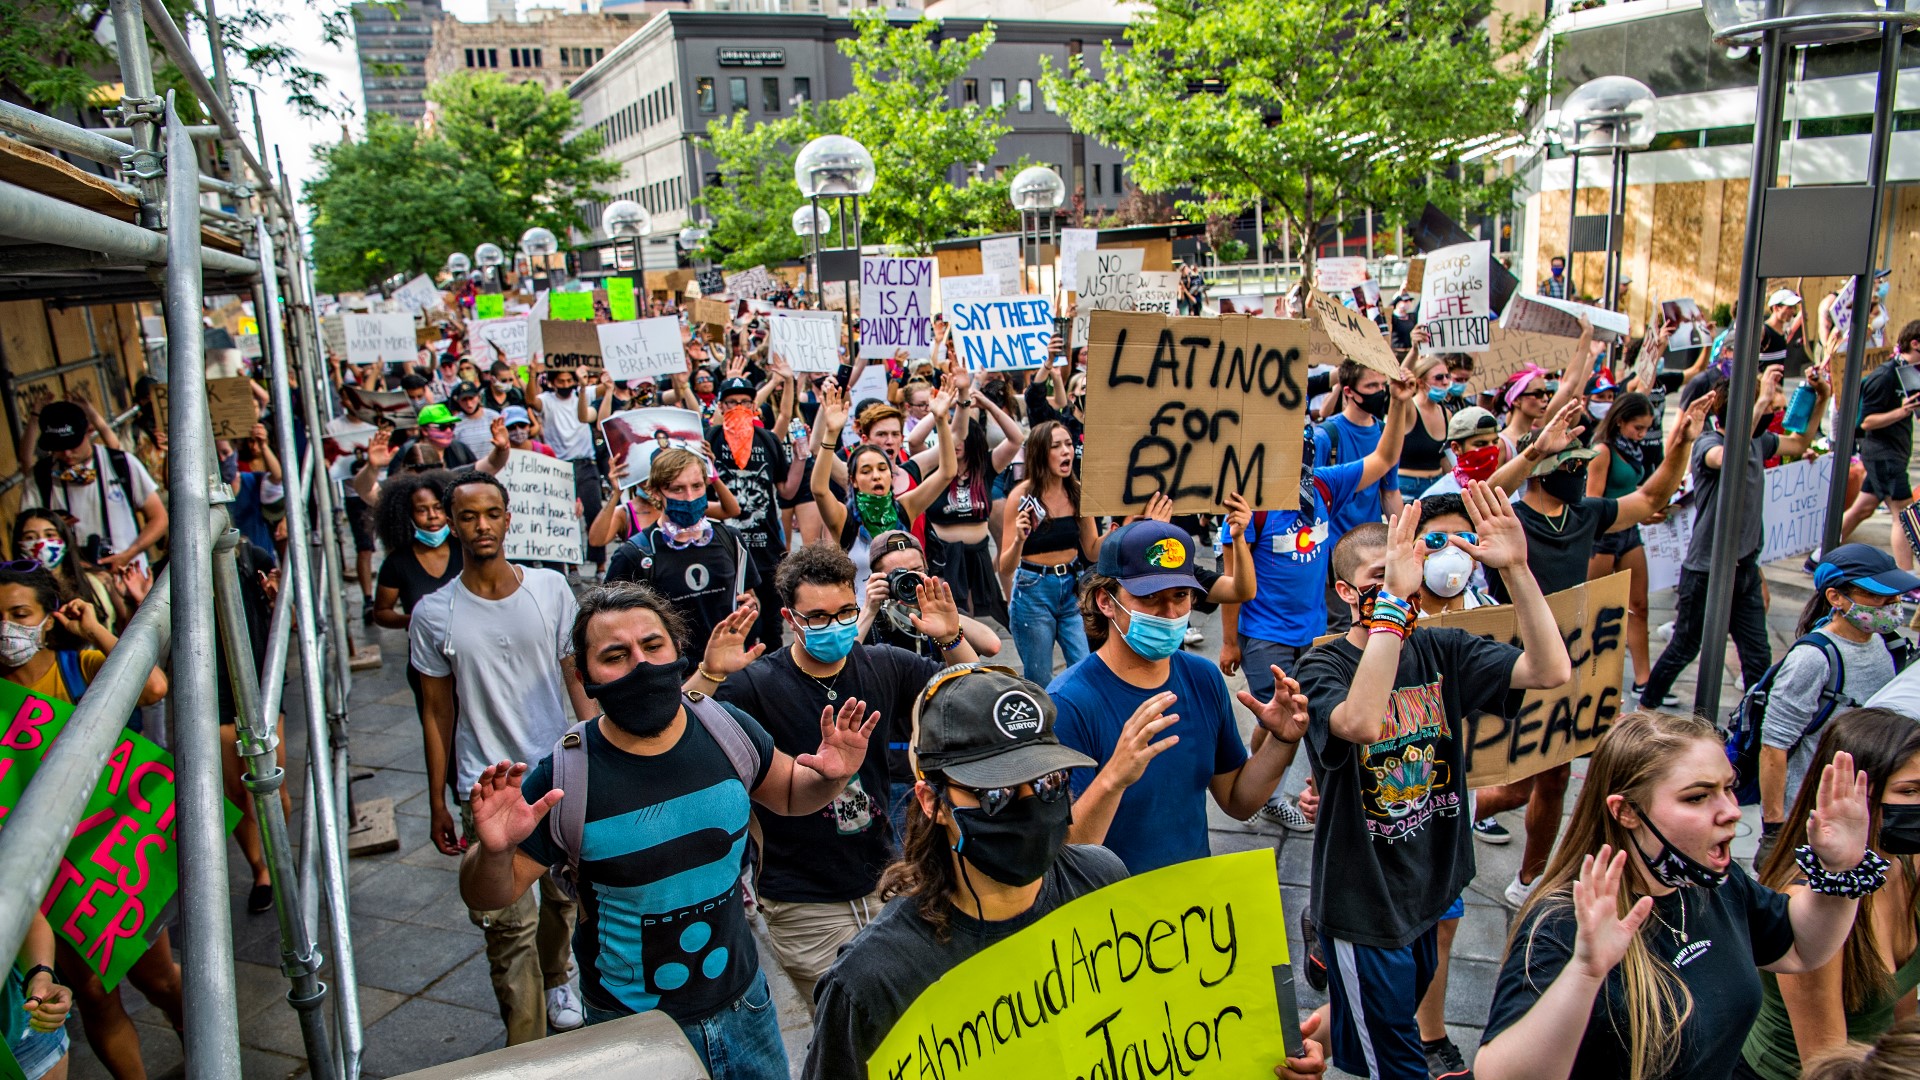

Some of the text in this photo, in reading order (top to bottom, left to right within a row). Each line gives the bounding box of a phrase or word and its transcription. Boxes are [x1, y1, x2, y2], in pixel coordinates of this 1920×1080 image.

[720, 51, 783, 60] URBAN LUXURY
[864, 259, 931, 287] RACISM
[1098, 255, 1121, 273] NO
[1427, 254, 1471, 277] George
[1079, 273, 1134, 298] JUSTICE
[1433, 276, 1483, 298] Floyd's
[880, 291, 920, 317] IS A
[953, 300, 1055, 330] SAY THEIR
[1426, 296, 1474, 320] LIFE
[356, 319, 382, 337] HOW
[1316, 298, 1366, 339] #BLM
[631, 322, 644, 340] I
[772, 318, 834, 349] NO JUSTICE
[860, 317, 931, 347] PANDEMIC
[351, 338, 381, 351] MANY
[605, 340, 648, 359] CAN'T
[962, 332, 1058, 370] NAMES
[619, 352, 682, 375] BREATHE
[1108, 328, 1302, 410] LATINOS
[520, 456, 550, 475] fellow
[1122, 434, 1265, 507] BLM
[521, 484, 542, 493] are
[543, 482, 572, 501] black
[1771, 458, 1832, 503] BLACK
[508, 501, 529, 515] ould
[531, 502, 545, 516] not
[548, 503, 568, 519] have
[1790, 494, 1818, 513] LIVES
[530, 520, 542, 534] in
[545, 521, 575, 537] fear
[525, 540, 554, 556] their
[1165, 540, 1180, 548] Bass
[1167, 555, 1184, 563] Shops
[1007, 721, 1038, 731] BURTON
[1466, 687, 1618, 772] PEACE
[1366, 819, 1396, 836] EW
[1672, 947, 1690, 969] JIMMY
